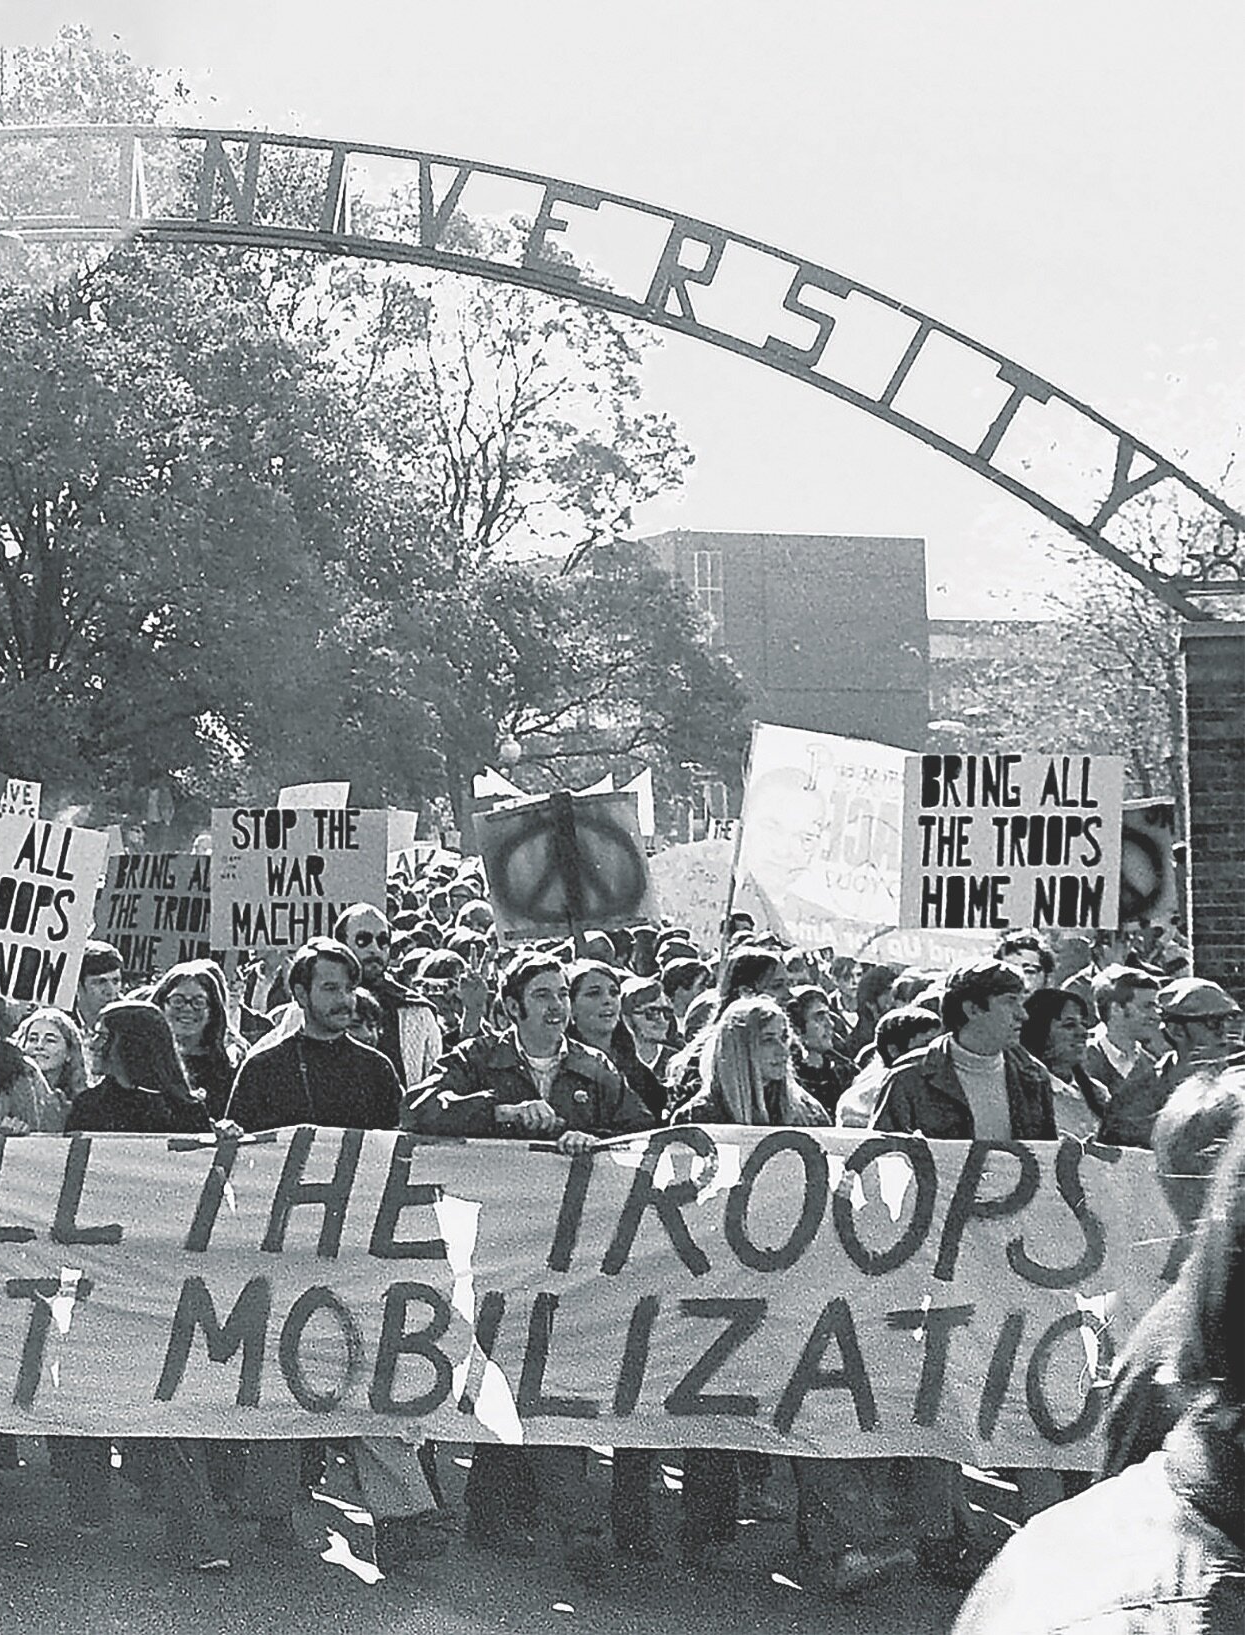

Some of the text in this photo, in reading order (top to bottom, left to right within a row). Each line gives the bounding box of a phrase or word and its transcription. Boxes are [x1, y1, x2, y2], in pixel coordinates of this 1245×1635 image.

[921, 755, 1022, 807] BRING
[1040, 756, 1099, 807] ALL
[13, 823, 74, 880] ALL
[232, 809, 361, 850] STOP THE
[918, 816, 973, 867] THE
[992, 815, 1102, 867] TROOPS
[114, 854, 178, 889] BRING
[188, 856, 211, 892] AL
[266, 855, 325, 897] WAR
[107, 894, 142, 929] THE
[921, 876, 1104, 928] HOME NOW
[167, 1127, 467, 1259] THE
[529, 1127, 1123, 1289] TROOPS
[155, 1277, 1115, 1444] MOBILIZATIO
